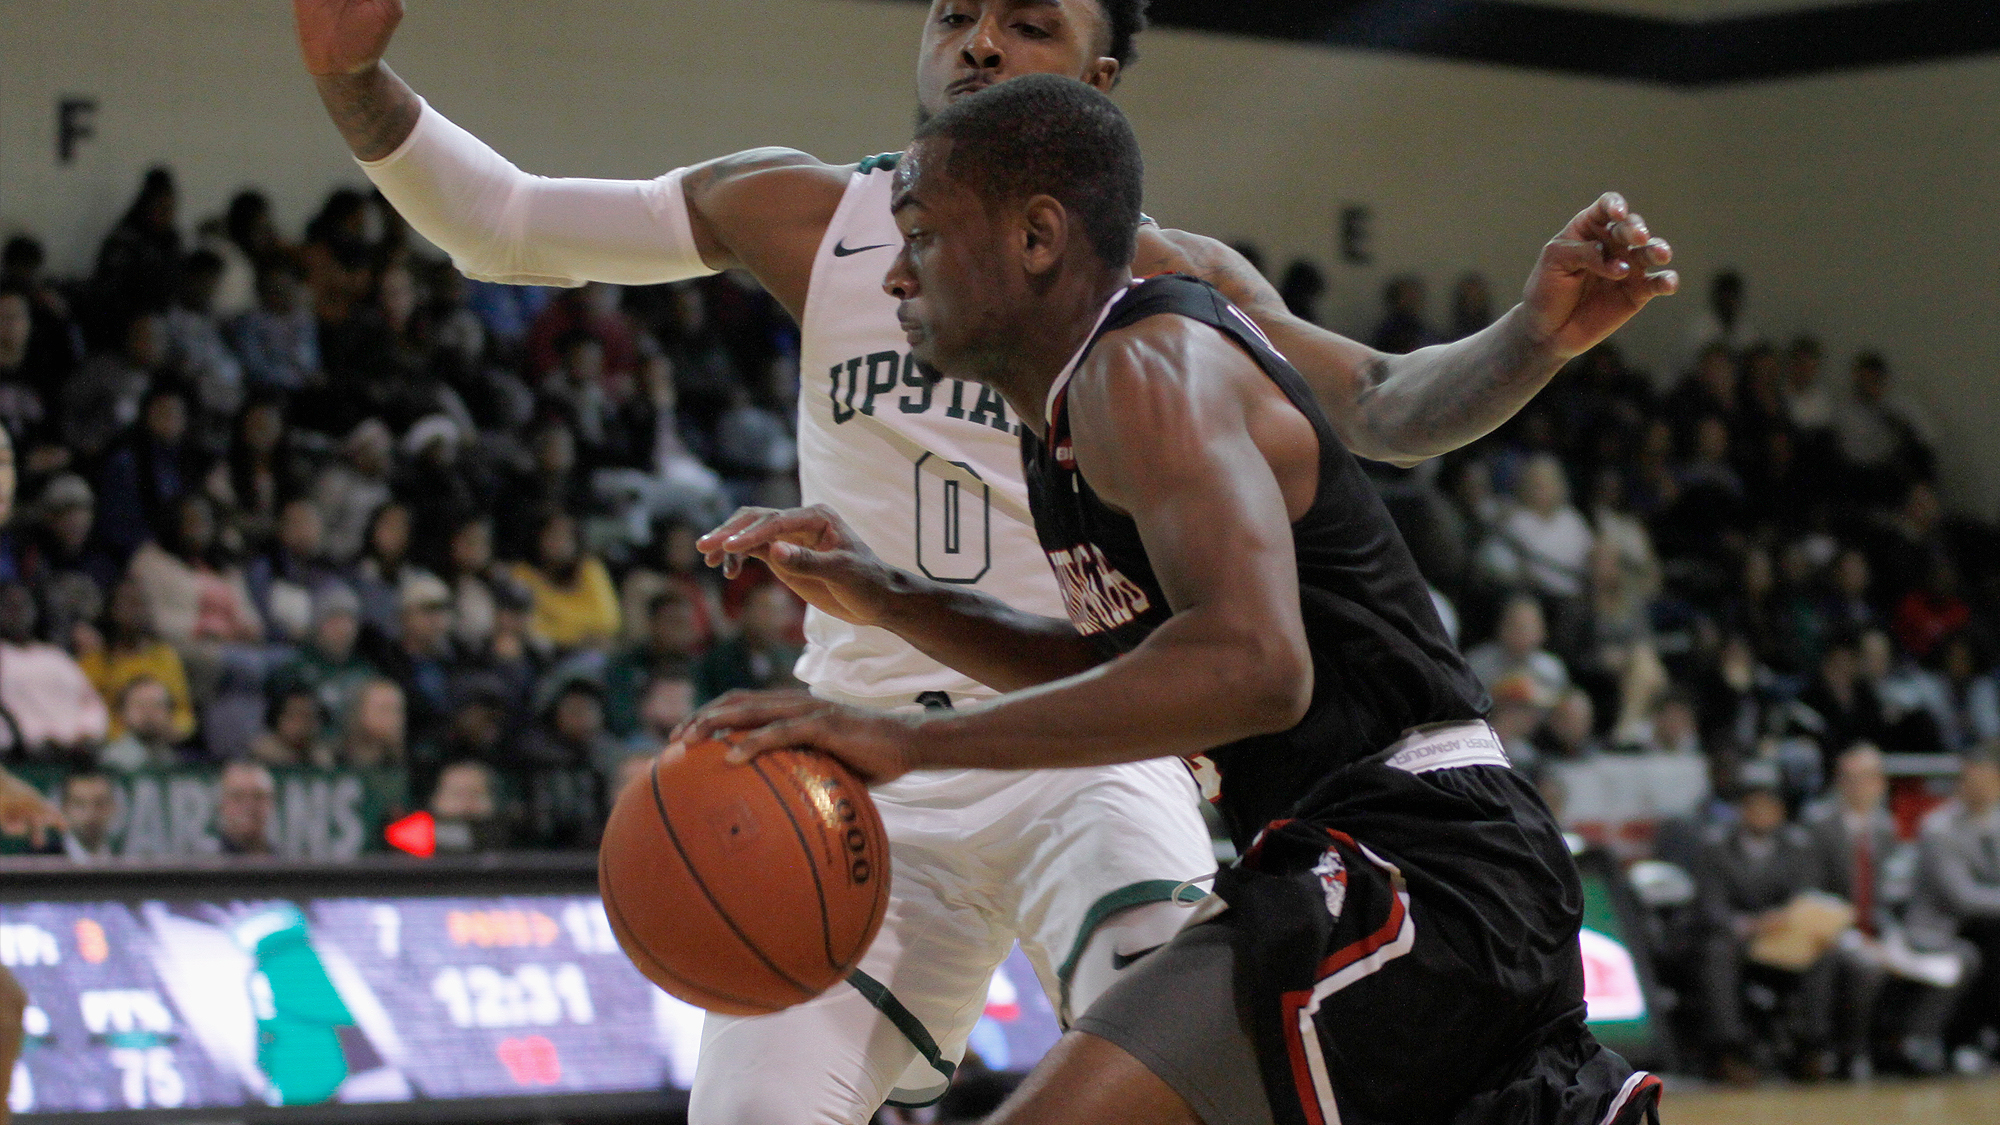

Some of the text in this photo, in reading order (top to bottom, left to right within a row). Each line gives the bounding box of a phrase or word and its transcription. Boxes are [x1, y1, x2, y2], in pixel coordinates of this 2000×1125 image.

[56, 97, 97, 164] F
[1340, 204, 1375, 266] E
[830, 350, 1021, 426] UPSTA
[914, 451, 990, 584] 0
[433, 963, 595, 1028] 12:31
